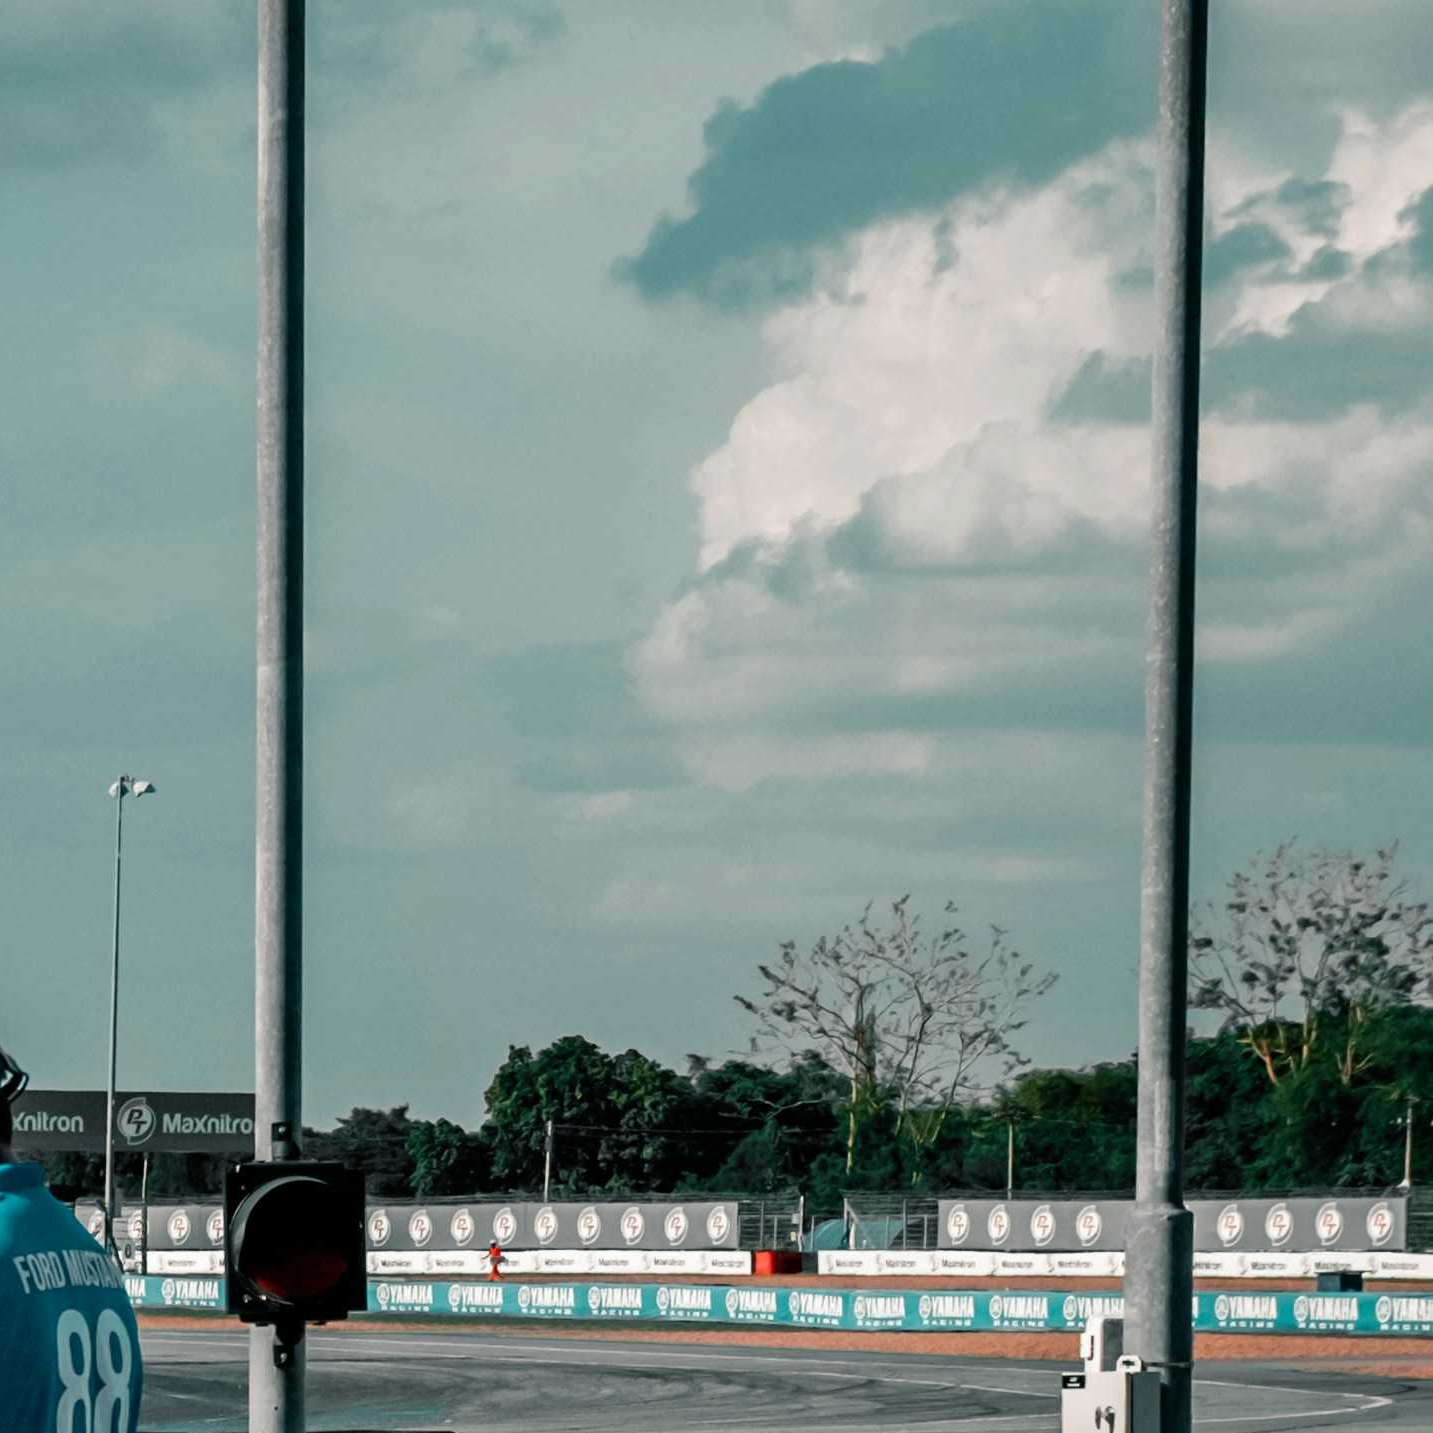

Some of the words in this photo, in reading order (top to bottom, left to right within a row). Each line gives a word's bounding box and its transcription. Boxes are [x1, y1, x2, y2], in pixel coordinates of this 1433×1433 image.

[12, 1112, 84, 1133] xnitron
[163, 1113, 254, 1133] Maxnitro
[13, 1251, 66, 1294] FORD
[62, 1249, 126, 1289] MUSTAN
[176, 1281, 218, 1298] YAMAHA
[389, 1285, 433, 1303] YAMAHA
[462, 1286, 503, 1305] YAMAHA
[531, 1288, 575, 1306] YAMAHA
[600, 1288, 642, 1307] YAMAHA
[669, 1289, 711, 1308] YAMAHA
[739, 1291, 777, 1311] YAMAHA
[800, 1294, 843, 1316] YAMAHA
[865, 1298, 905, 1318] YAMAHA
[933, 1297, 975, 1317] YAMAHA
[1003, 1297, 1048, 1318] YAMAHA
[1230, 1297, 1277, 1318] YAMAHA
[1309, 1298, 1358, 1320] YAMAHA
